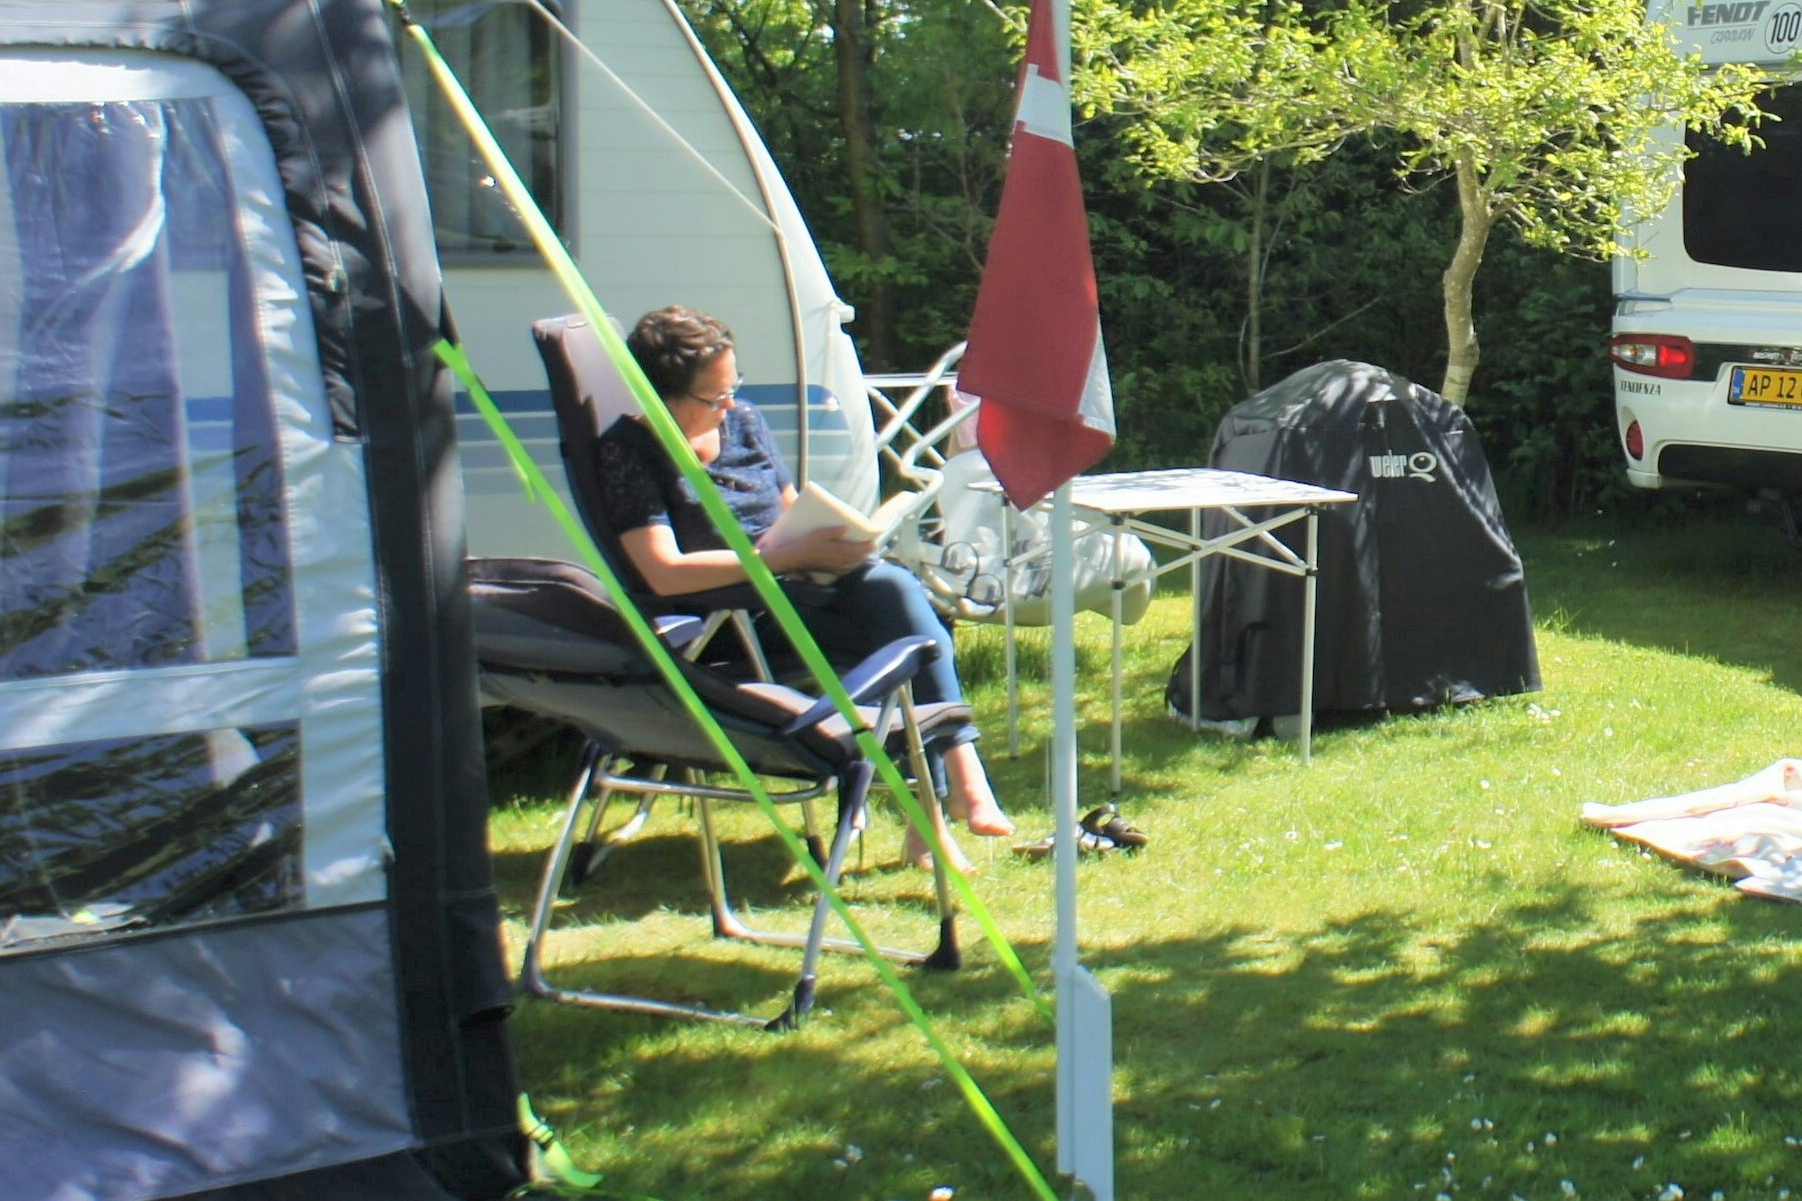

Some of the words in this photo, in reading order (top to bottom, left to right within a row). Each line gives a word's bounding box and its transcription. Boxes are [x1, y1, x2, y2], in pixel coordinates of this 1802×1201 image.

[1687, 0, 1771, 26] FENDT
[1770, 11, 1801, 44] 100
[1747, 374, 1771, 397] AP
[1776, 376, 1797, 399] 12
